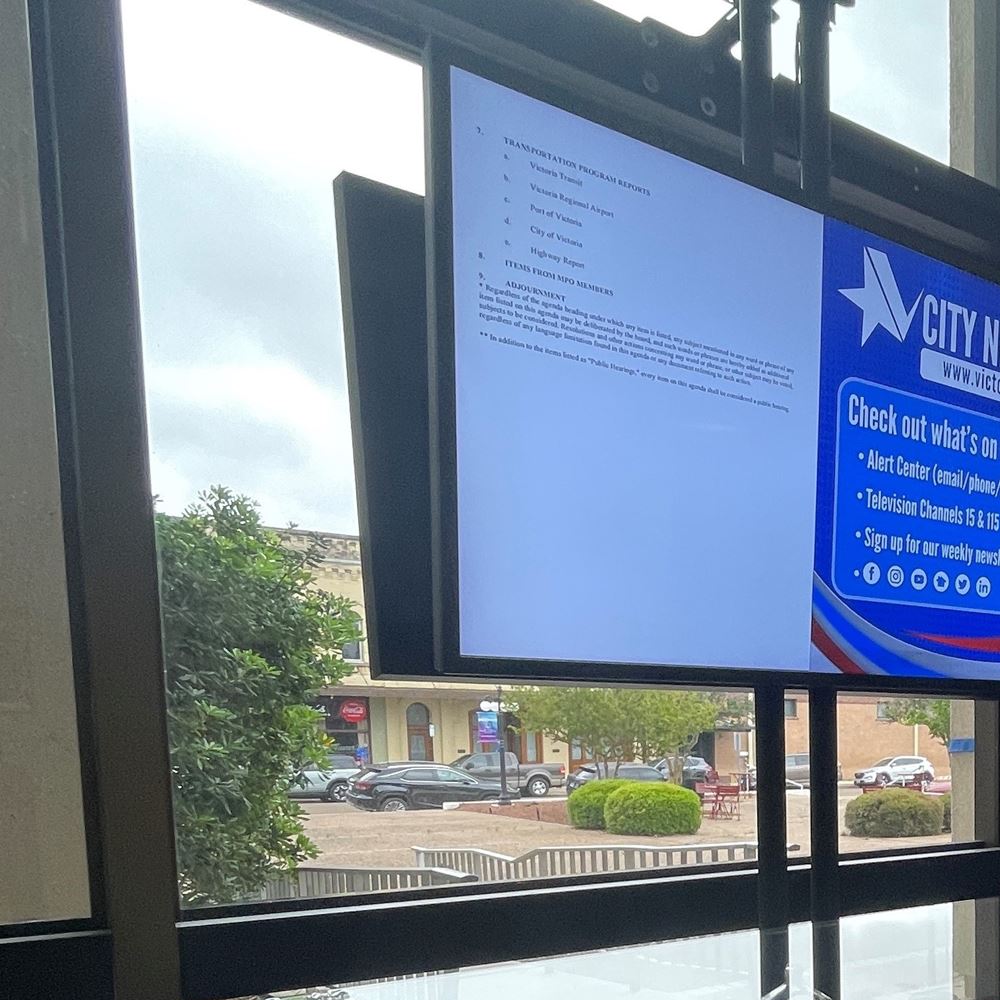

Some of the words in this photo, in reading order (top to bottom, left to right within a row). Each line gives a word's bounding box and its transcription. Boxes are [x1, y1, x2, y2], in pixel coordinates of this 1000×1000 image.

[504, 136, 577, 170] TRANSPORTATION
[579, 164, 616, 185] PROGRAM
[619, 179, 651, 197] REPORTS
[530, 161, 558, 178] Victoria
[560, 172, 583, 187] Transit
[530, 183, 558, 199] Victoria
[560, 193, 589, 211] Regional
[591, 204, 614, 220] Airport
[531, 204, 545, 216] Port
[546, 209, 554, 219] of
[556, 212, 582, 228] Victoria
[531, 225, 545, 238] City
[547, 230, 554, 239] of
[556, 233, 583, 248] Victoria
[531, 247, 562, 264] Highway
[563, 256, 584, 271] Report
[505, 259, 531, 273] ITEMS
[533, 267, 556, 280] FROM
[558, 275, 575, 286] MPO
[577, 280, 614, 297] MEMBERS
[505, 279, 566, 303] ADJOURNMENT
[922, 294, 977, 358] CITY
[848, 394, 897, 435] Check
[902, 415, 927, 443] out
[931, 419, 978, 455] what's
[982, 436, 998, 460] on
[867, 449, 894, 474] Alert
[897, 455, 930, 481] Center
[866, 488, 917, 517] Television
[920, 498, 963, 525] Channels
[966, 507, 976, 527] 15
[977, 510, 985, 529] &
[987, 512, 1000, 532] 115
[864, 526, 888, 553] Sign
[890, 535, 903, 556] up
[906, 533, 921, 554] for
[923, 540, 940, 557] our
[942, 542, 973, 566] weekly
